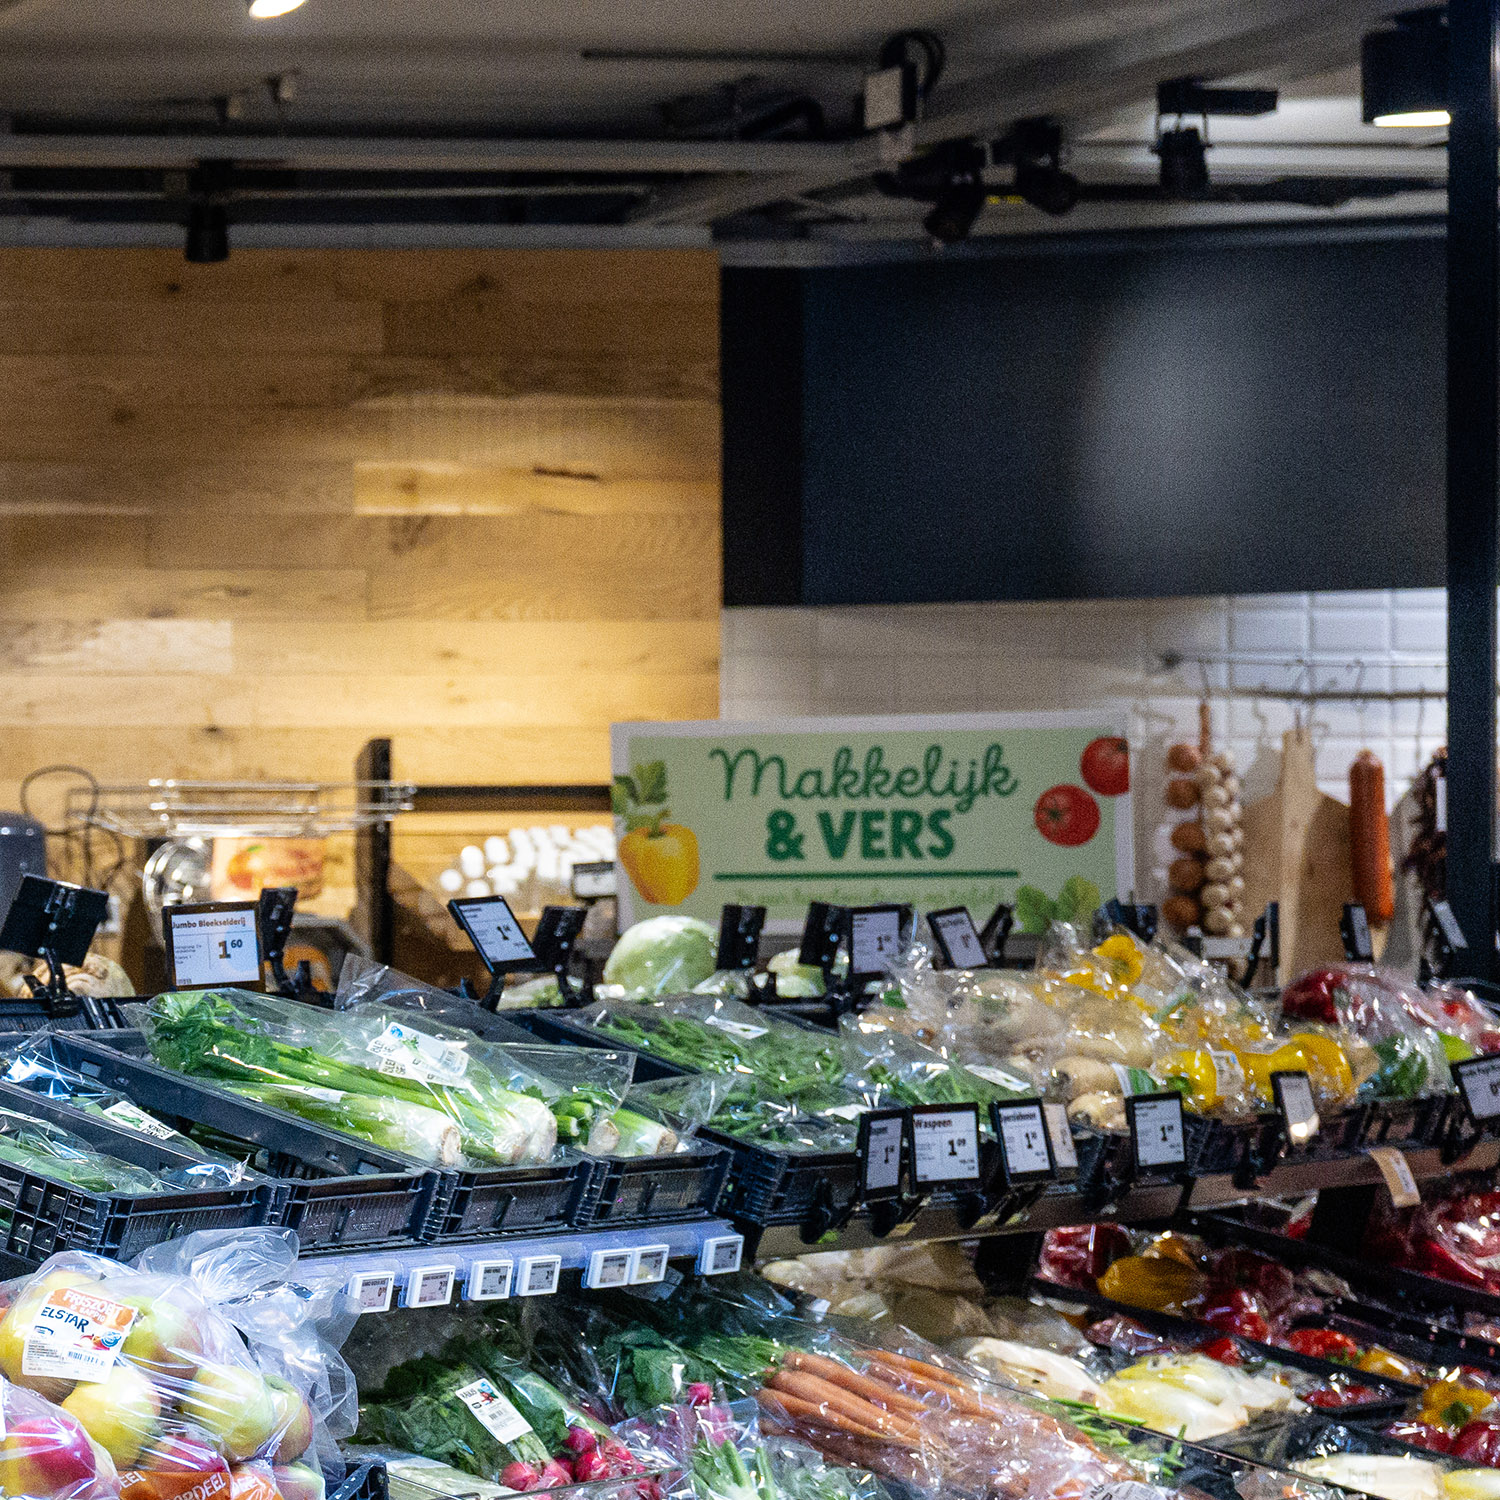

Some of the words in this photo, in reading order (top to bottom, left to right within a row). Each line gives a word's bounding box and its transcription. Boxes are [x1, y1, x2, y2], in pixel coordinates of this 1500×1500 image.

[707, 743, 1019, 815] Makkelijk
[765, 808, 805, 862] &
[816, 807, 957, 861] VERS
[40, 1306, 90, 1333] ELSTAR
